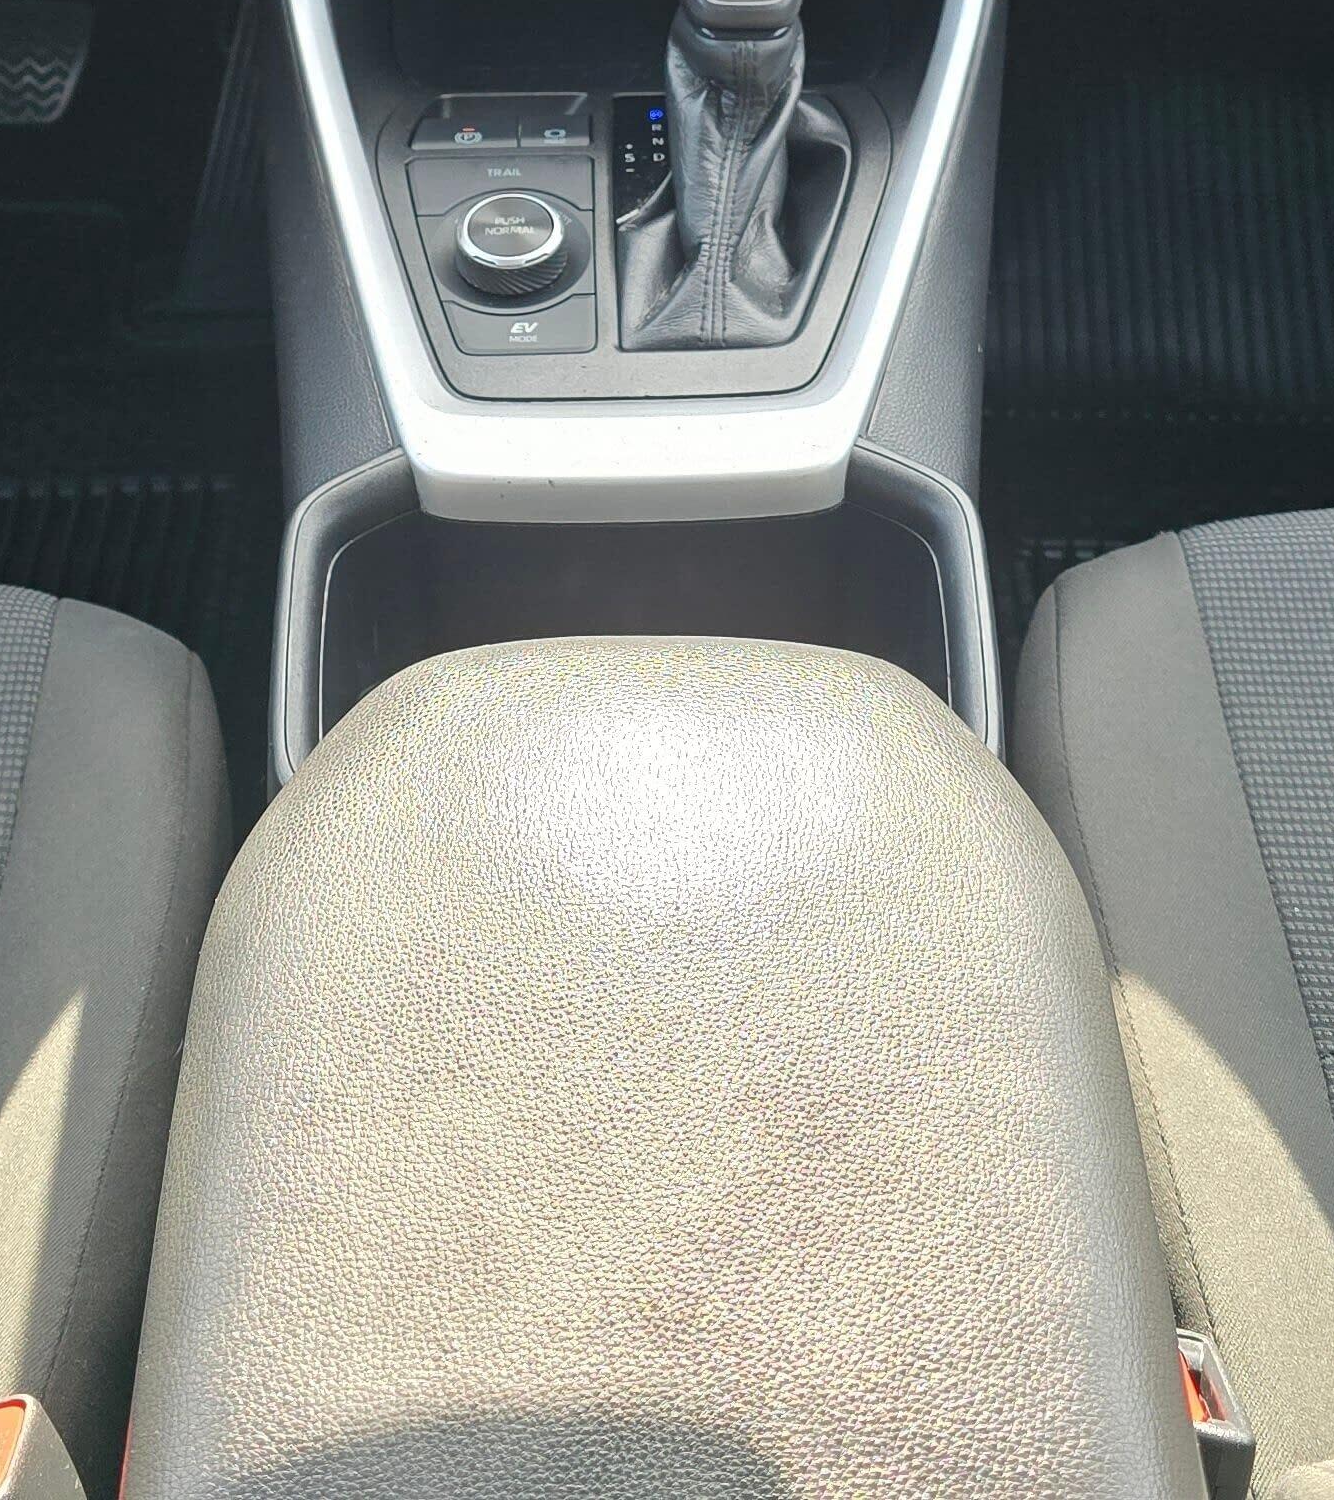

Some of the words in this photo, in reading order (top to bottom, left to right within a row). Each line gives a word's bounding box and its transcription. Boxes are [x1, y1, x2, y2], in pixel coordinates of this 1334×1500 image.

[624, 153, 636, 163] S
[653, 152, 665, 162] D
[487, 167, 522, 177] TRAIL
[494, 216, 526, 225] PUSH
[484, 226, 536, 236] NORMAL
[510, 321, 540, 334] EV
[508, 334, 539, 344] MODE
